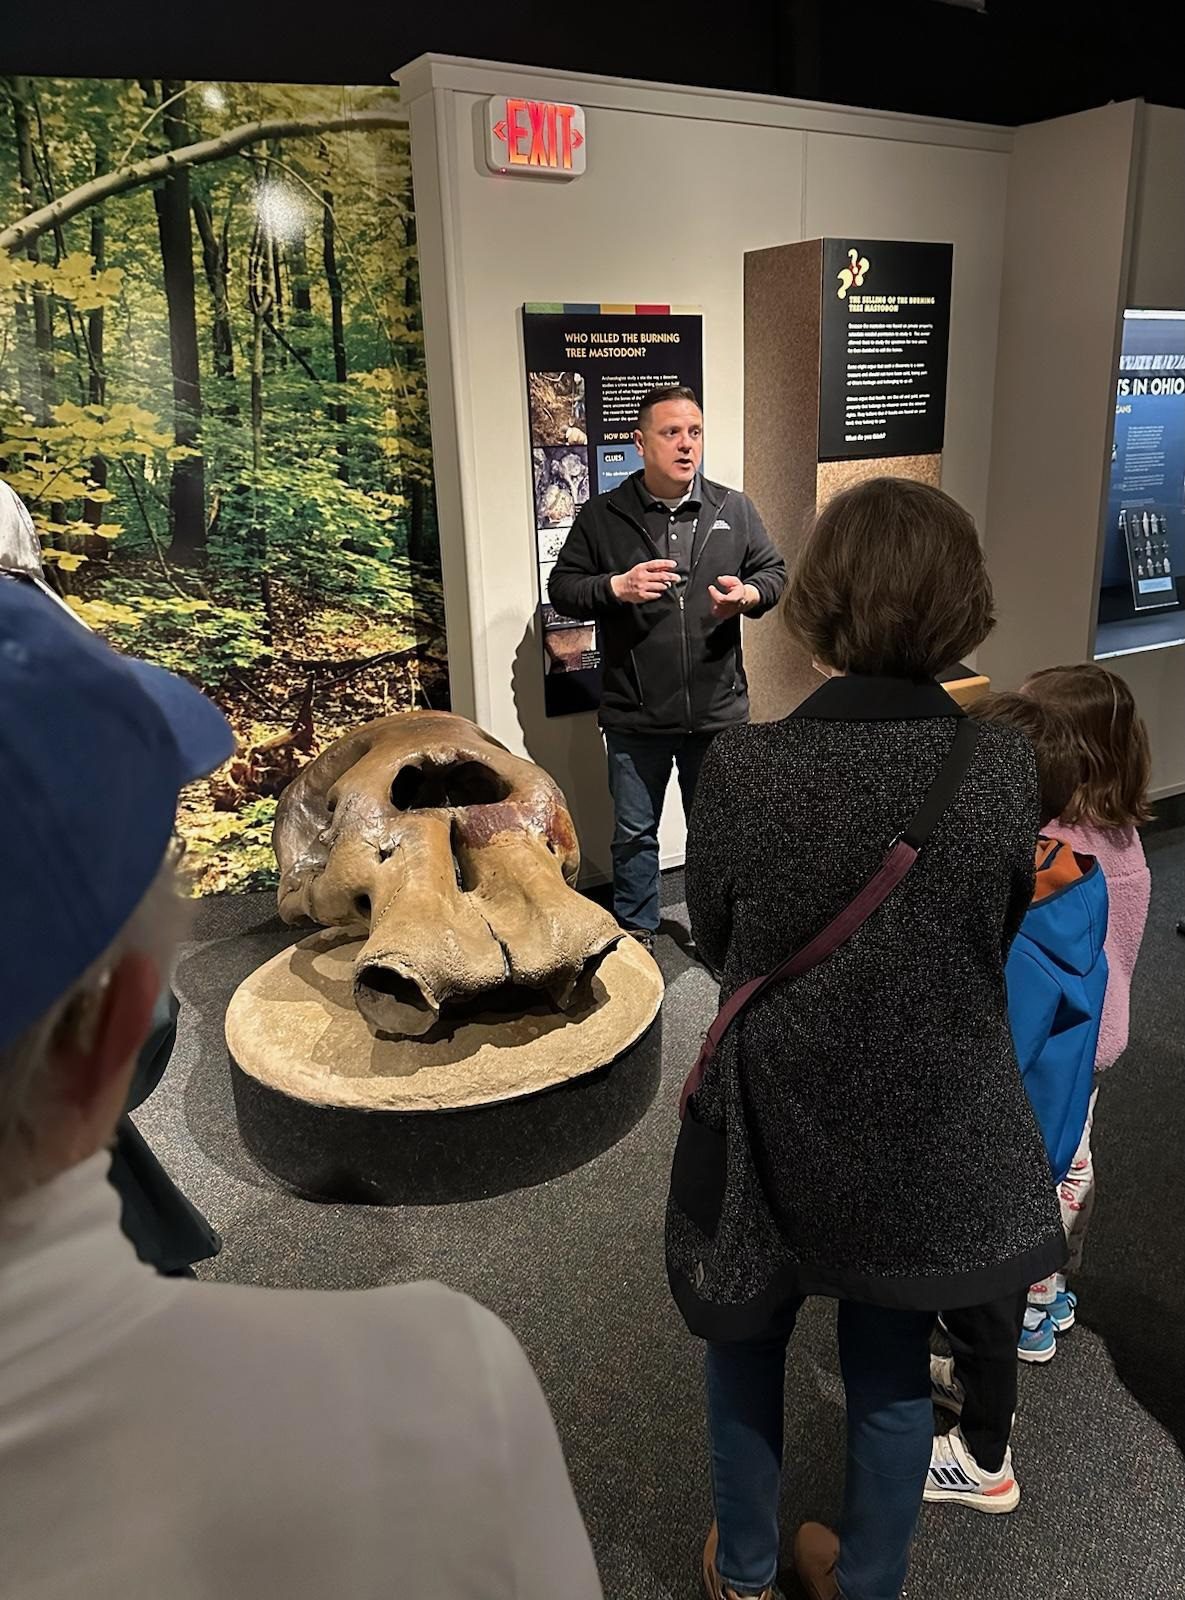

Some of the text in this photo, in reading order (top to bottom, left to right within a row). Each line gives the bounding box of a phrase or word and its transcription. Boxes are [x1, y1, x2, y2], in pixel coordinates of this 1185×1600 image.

[507, 99, 575, 168] EXIT
[887, 296, 896, 304] OF
[864, 304, 899, 312] MASTODON
[565, 333, 680, 343] WHO KILLED THE BURNING
[566, 347, 646, 358] TREE MASTODON?
[1133, 378, 1148, 396] IN
[1151, 378, 1184, 395] OHIO
